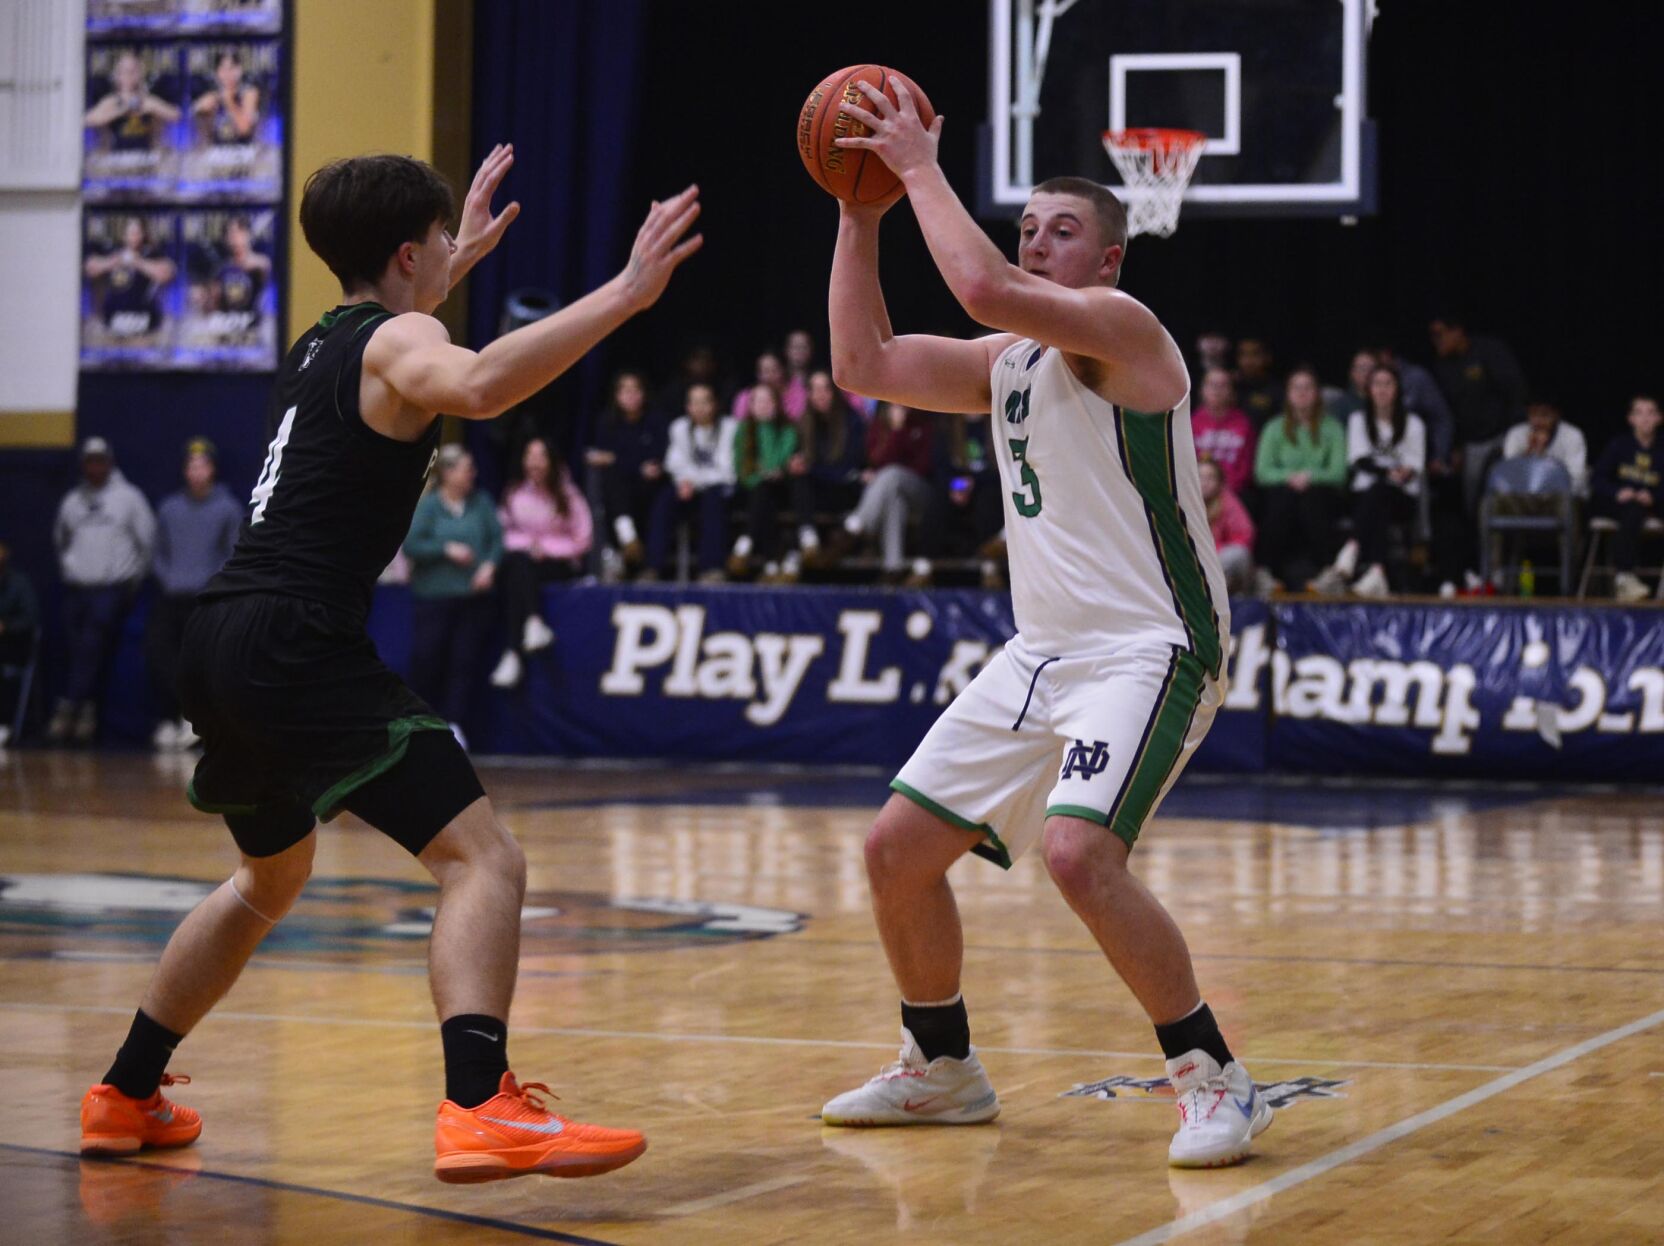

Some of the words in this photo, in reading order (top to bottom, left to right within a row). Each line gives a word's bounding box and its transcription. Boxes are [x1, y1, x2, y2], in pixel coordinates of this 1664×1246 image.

[826, 81, 864, 173] SPLDNG
[249, 405, 297, 526] 4
[601, 604, 824, 726] Play
[827, 610, 1003, 704] Lik
[1224, 621, 1664, 753] hampion
[1061, 739, 1110, 780] ND
